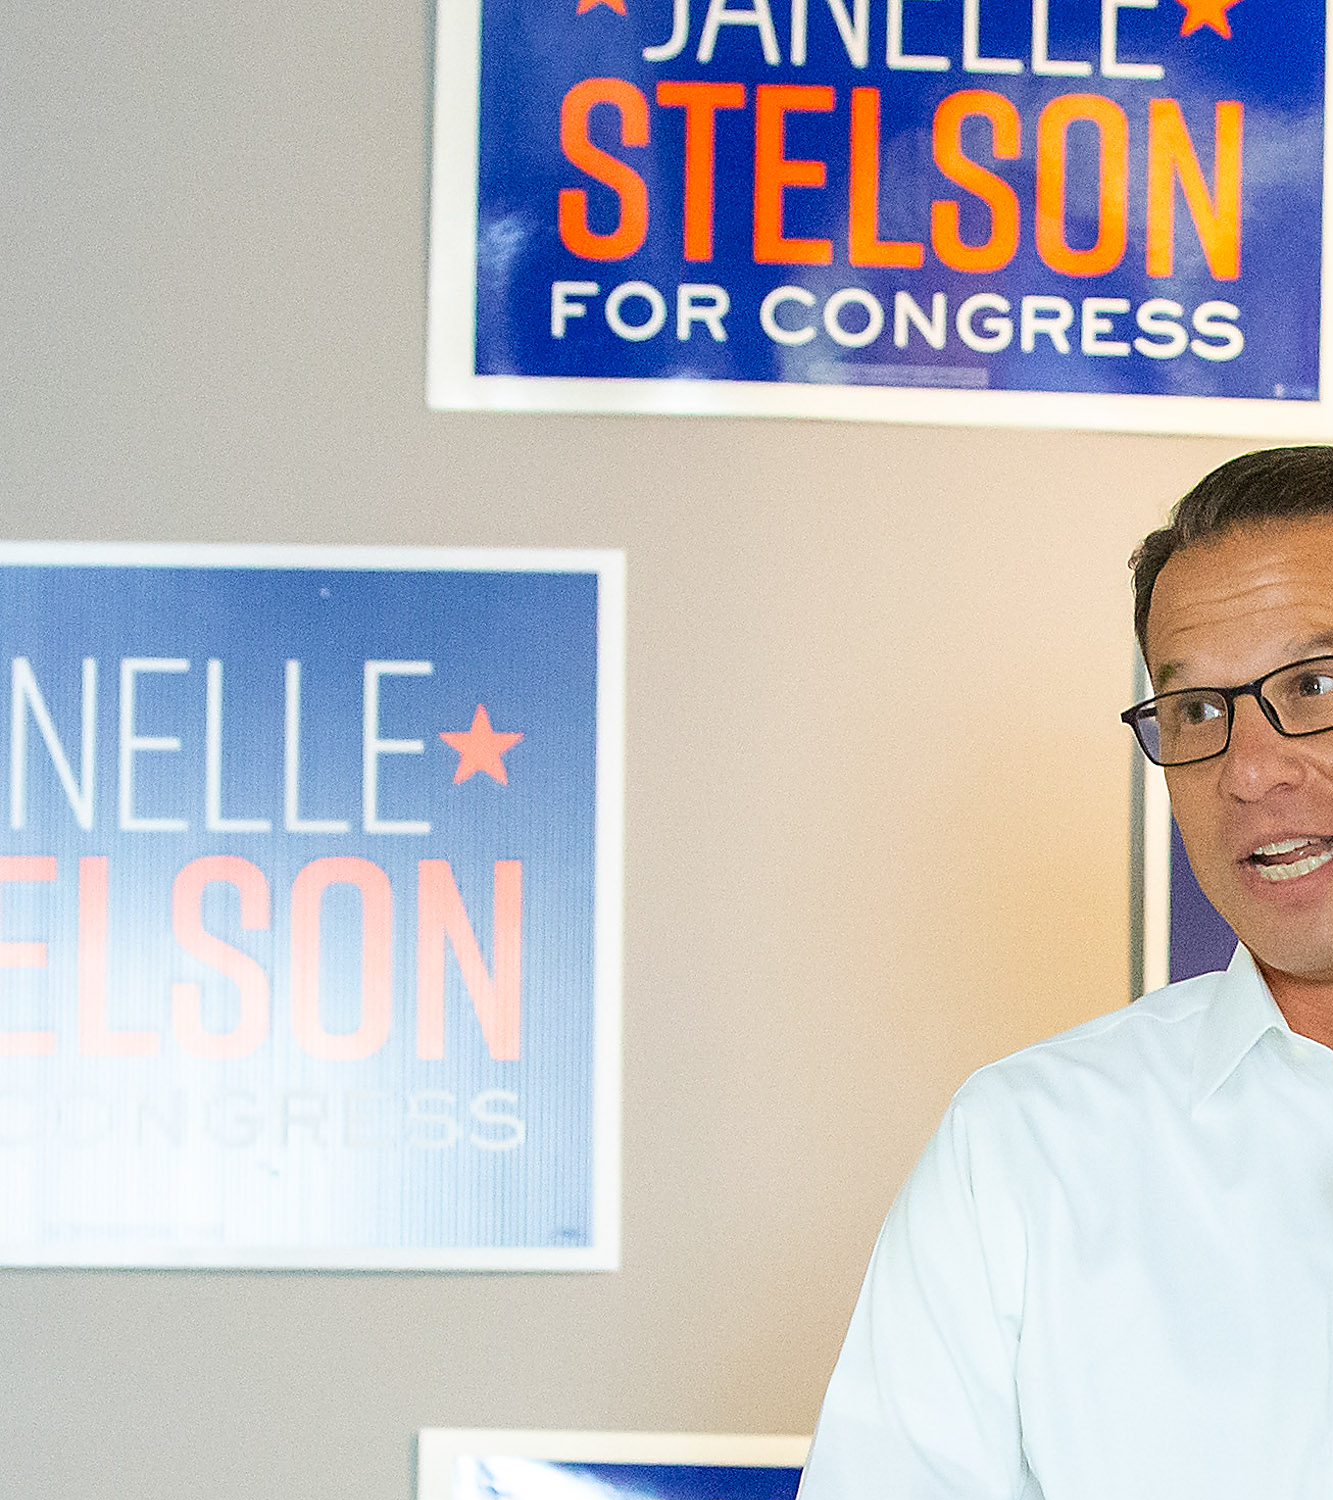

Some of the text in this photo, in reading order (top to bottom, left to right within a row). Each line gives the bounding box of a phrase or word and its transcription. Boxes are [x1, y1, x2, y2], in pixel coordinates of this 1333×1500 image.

[558, 77, 1244, 281] STELSON
[549, 281, 1245, 362] FOR CONGRESS
